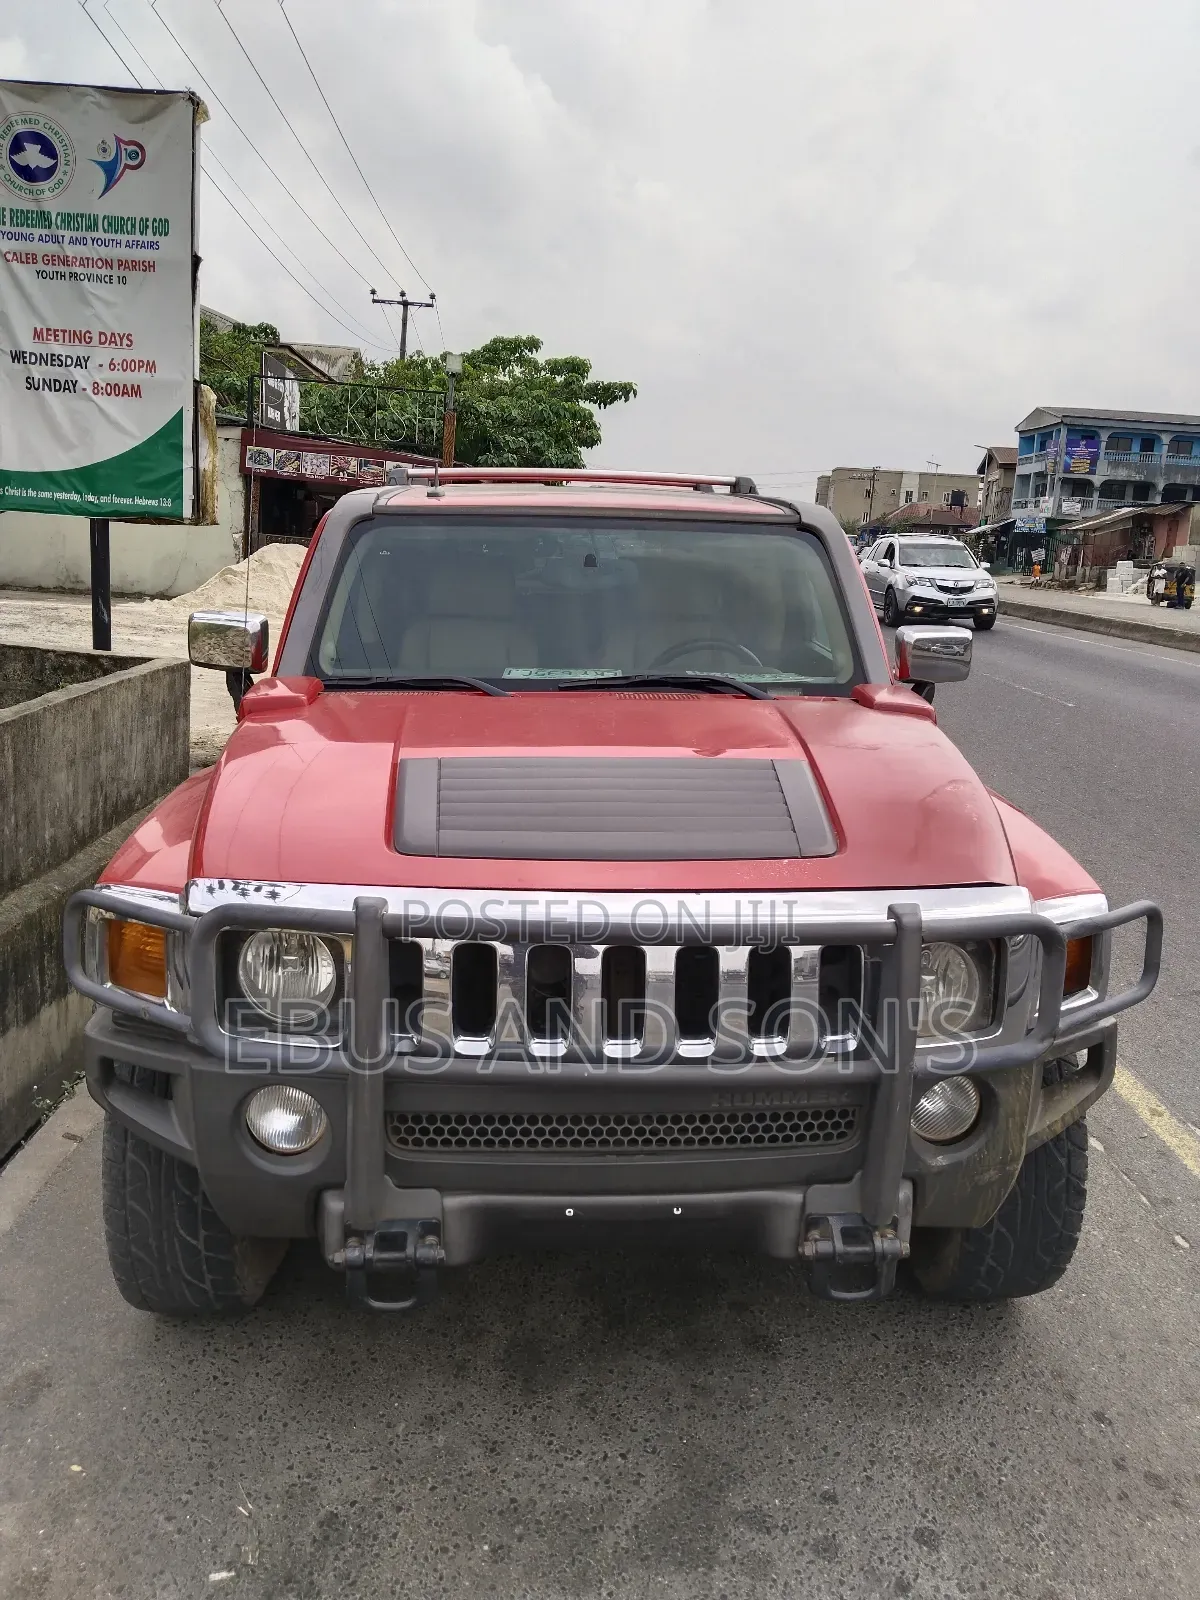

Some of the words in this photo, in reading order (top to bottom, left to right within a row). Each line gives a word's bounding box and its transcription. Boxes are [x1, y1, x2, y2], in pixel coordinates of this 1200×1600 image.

[1, 117, 40, 141] REDEEMED
[43, 122, 71, 167] CHRISTIAN
[3, 173, 34, 196] CHURCH
[48, 178, 64, 193] GOD
[9, 207, 52, 230] REDEEMED
[55, 211, 99, 233] CHRISTIAN
[102, 214, 136, 236] CHURCH
[138, 216, 149, 237] OF
[152, 217, 170, 237] GOD
[0, 230, 35, 243] YOUNG
[37, 234, 66, 245] ADULT
[68, 236, 88, 247] AND
[90, 237, 122, 249] YOUTH
[124, 240, 160, 251] AFFAIRS
[3, 250, 38, 265] CALEB
[41, 253, 113, 271] GENERATION
[117, 258, 156, 273] PARISH
[35, 269, 66, 282] YOUTH
[68, 271, 114, 285] PROVINCE
[117, 275, 127, 286] 10
[33, 326, 93, 345] MEETING
[98, 331, 134, 348] DAYS
[10, 349, 91, 370] WEDNESDAY
[108, 357, 157, 374] 6:00PM
[25, 376, 79, 394] SUNDAY
[92, 381, 142, 399] 8:00AM
[5, 486, 21, 496] Christ
[21, 488, 26, 497] is
[28, 488, 37, 498] the
[38, 491, 53, 499] same
[100, 494, 111, 503] and
[112, 494, 134, 505] forever.
[134, 496, 159, 507] Hebrews
[160, 498, 172, 507] 13:8
